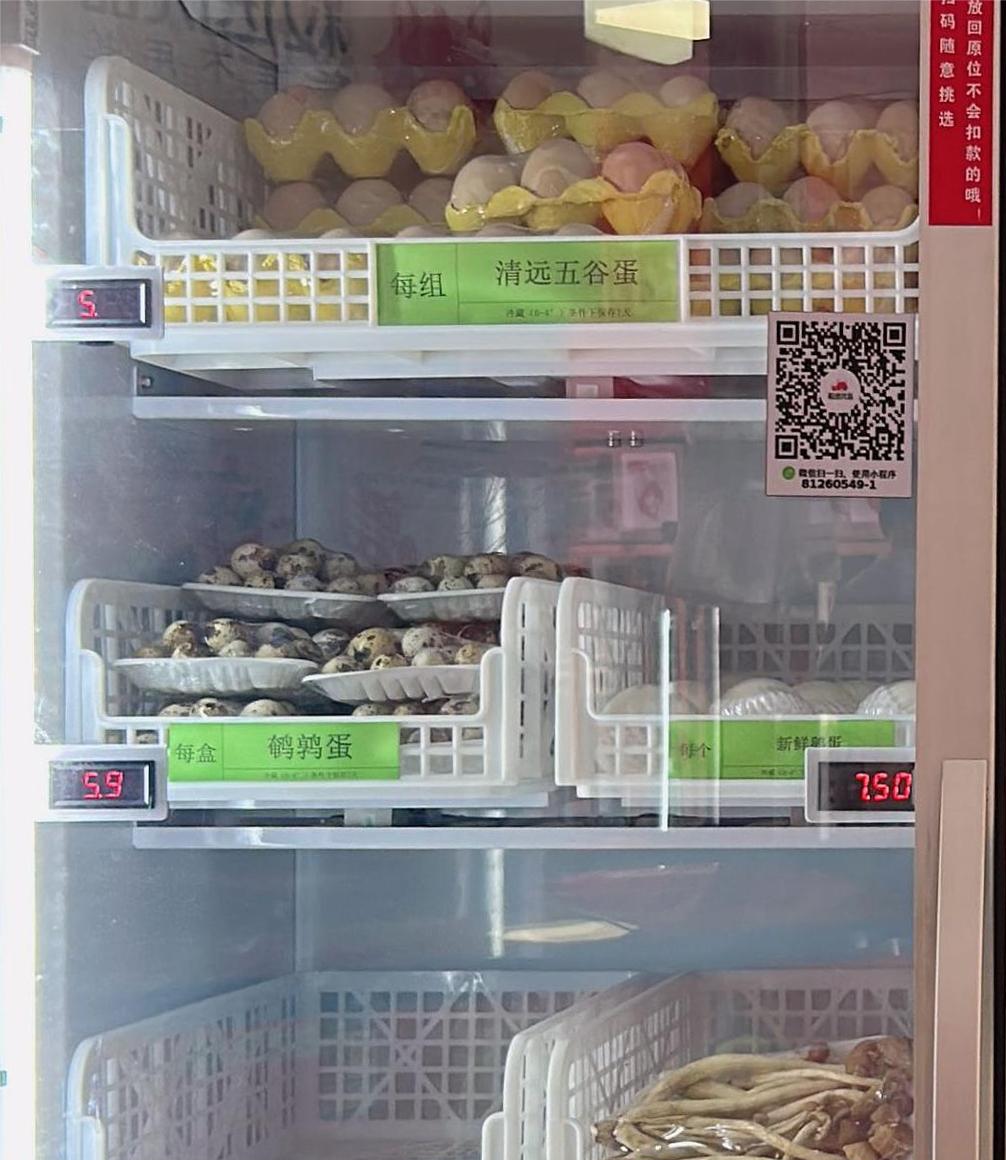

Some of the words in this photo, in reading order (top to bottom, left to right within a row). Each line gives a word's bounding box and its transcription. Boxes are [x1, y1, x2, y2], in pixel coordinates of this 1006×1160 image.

[938, 0, 956, 127] 码随意挑选
[390, 271, 447, 299] 每组
[495, 259, 640, 287] 清远五谷蛋
[801, 479, 877, 490] 81260549-1
[175, 743, 218, 764] 每盒
[267, 733, 354, 761] 鹌鹑蛋
[855, 772, 914, 801] 7.50
